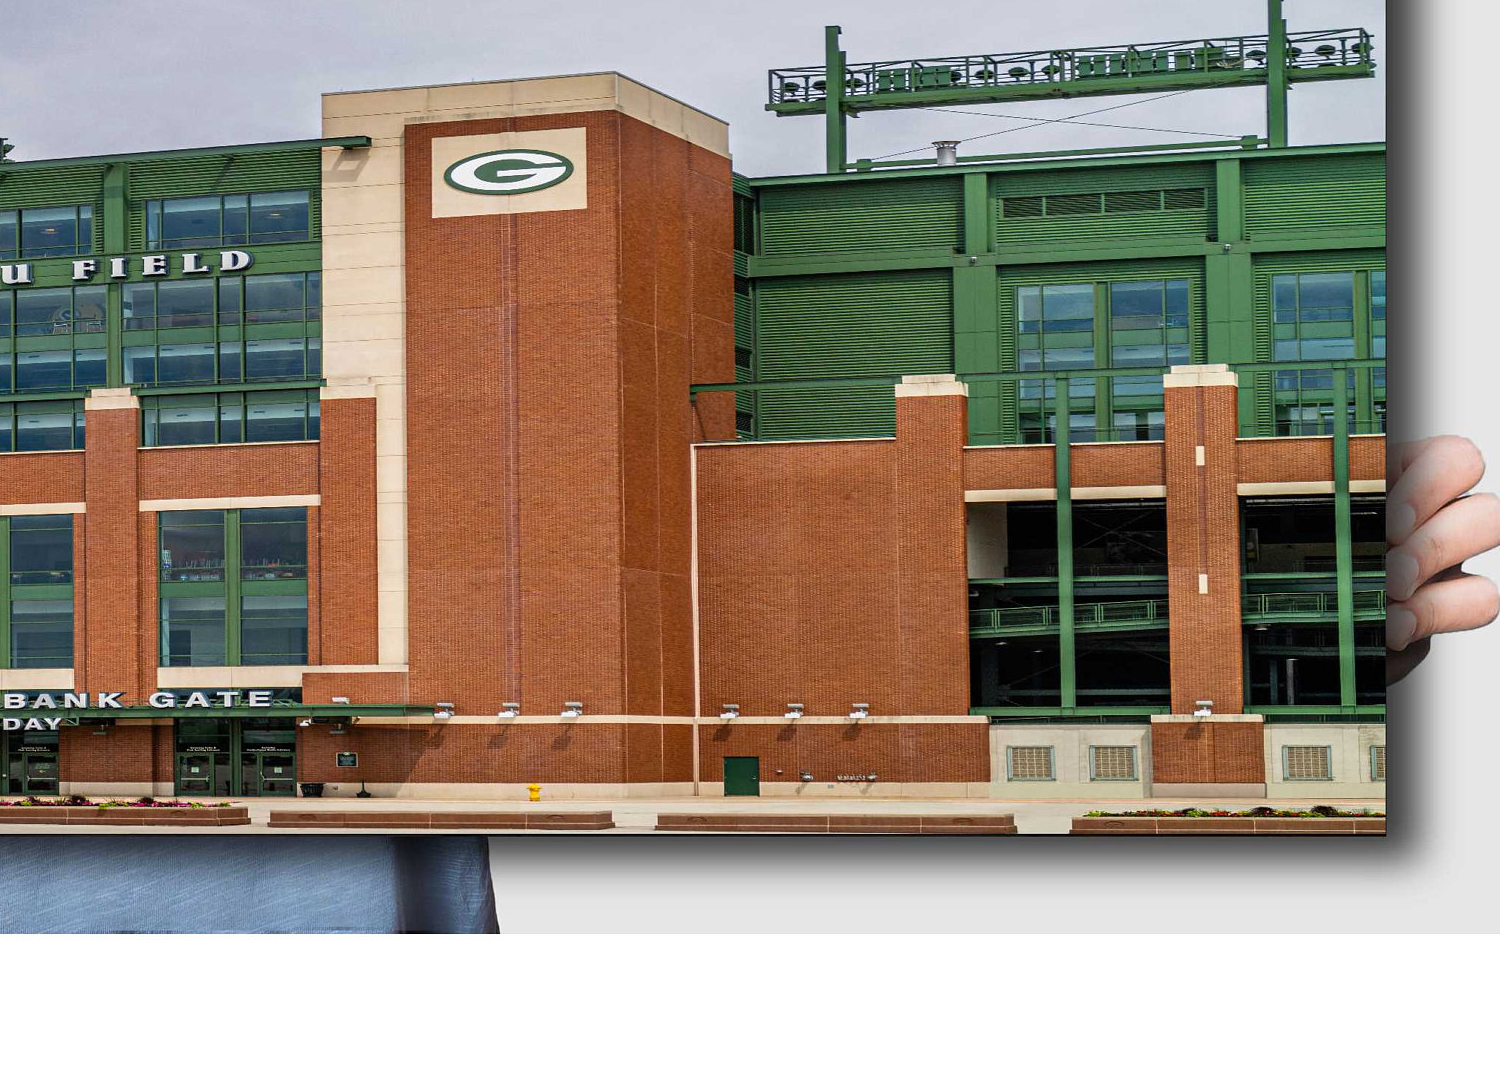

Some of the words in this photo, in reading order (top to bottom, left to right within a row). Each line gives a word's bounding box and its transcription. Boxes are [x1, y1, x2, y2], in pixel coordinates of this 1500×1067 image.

[449, 152, 568, 192] G
[72, 249, 252, 280] FIELD
[4, 692, 124, 709] BANK
[149, 691, 272, 708] GATE
[3, 717, 63, 731] DAY
